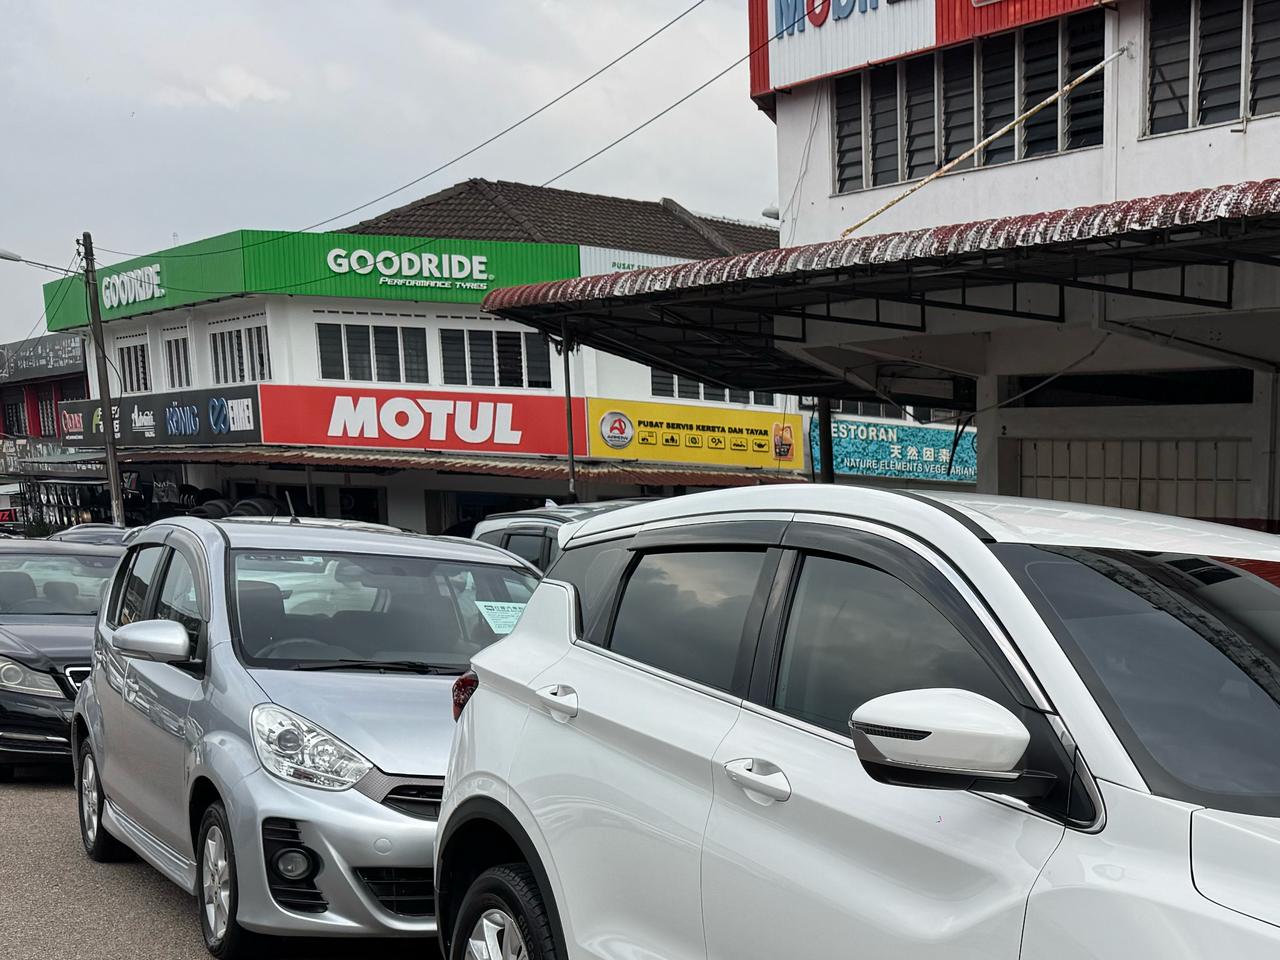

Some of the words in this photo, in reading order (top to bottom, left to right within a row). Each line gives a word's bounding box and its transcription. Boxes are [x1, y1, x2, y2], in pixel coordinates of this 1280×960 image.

[327, 248, 488, 280] GOODRIDE
[102, 264, 161, 309] GOODRIDE
[379, 277, 451, 288] PERFORMANCE
[327, 396, 522, 444] MOTUL
[638, 420, 664, 429] PUSAT
[666, 422, 693, 431] SERVIS
[696, 424, 726, 433] KERETA
[745, 428, 769, 436] TAYAR
[831, 423, 897, 441] ESTORAN
[844, 458, 880, 469] NATURE
[880, 460, 922, 472] ELEMENTS
[925, 465, 975, 476] VEGEARIAN
